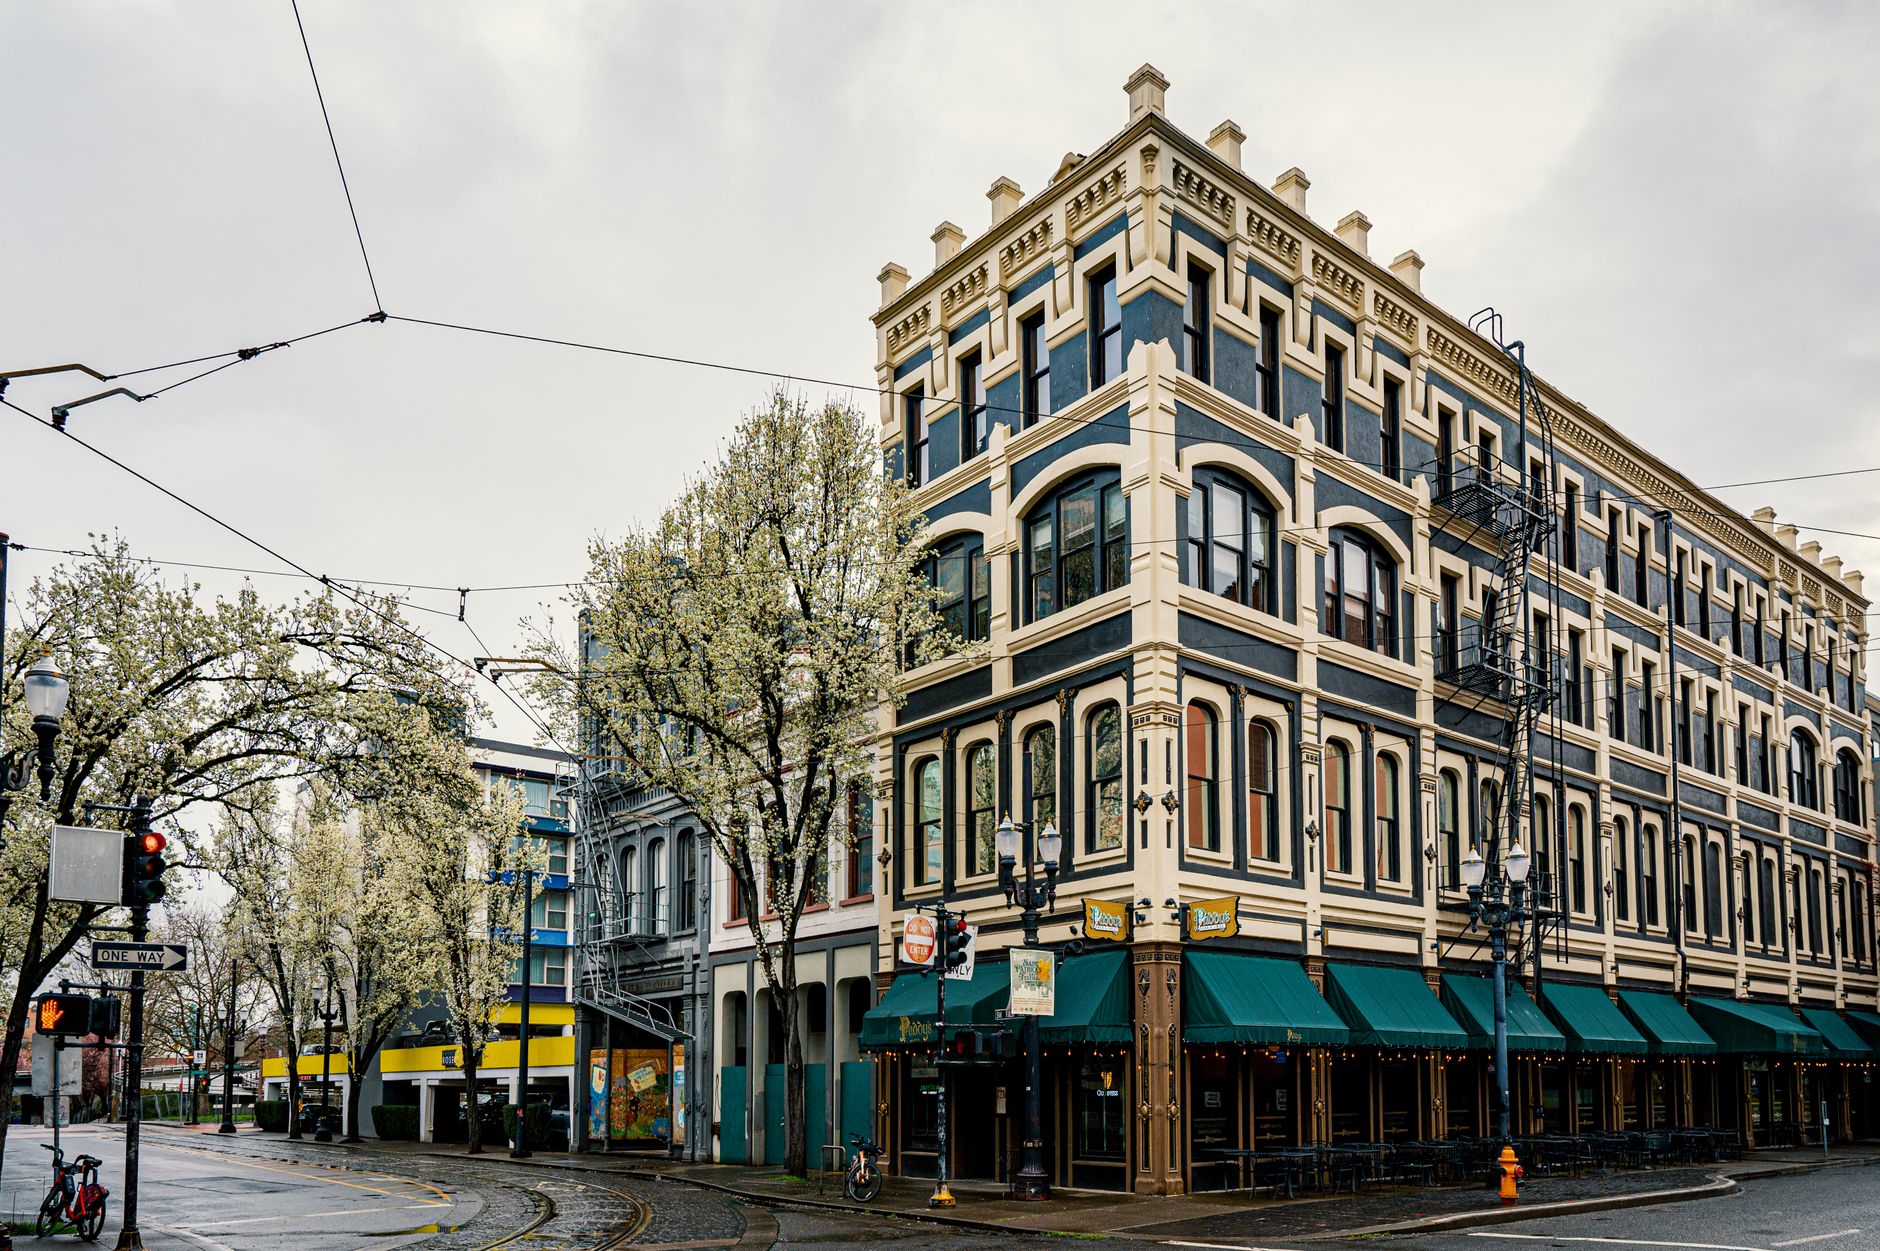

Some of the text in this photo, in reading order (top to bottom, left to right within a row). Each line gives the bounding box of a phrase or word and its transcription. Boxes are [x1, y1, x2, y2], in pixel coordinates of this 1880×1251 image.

[909, 924, 932, 934] DO NOT
[909, 945, 929, 955] ENTER
[101, 950, 166, 963] ONE WAY
[900, 1016, 932, 1042] Paddy's
